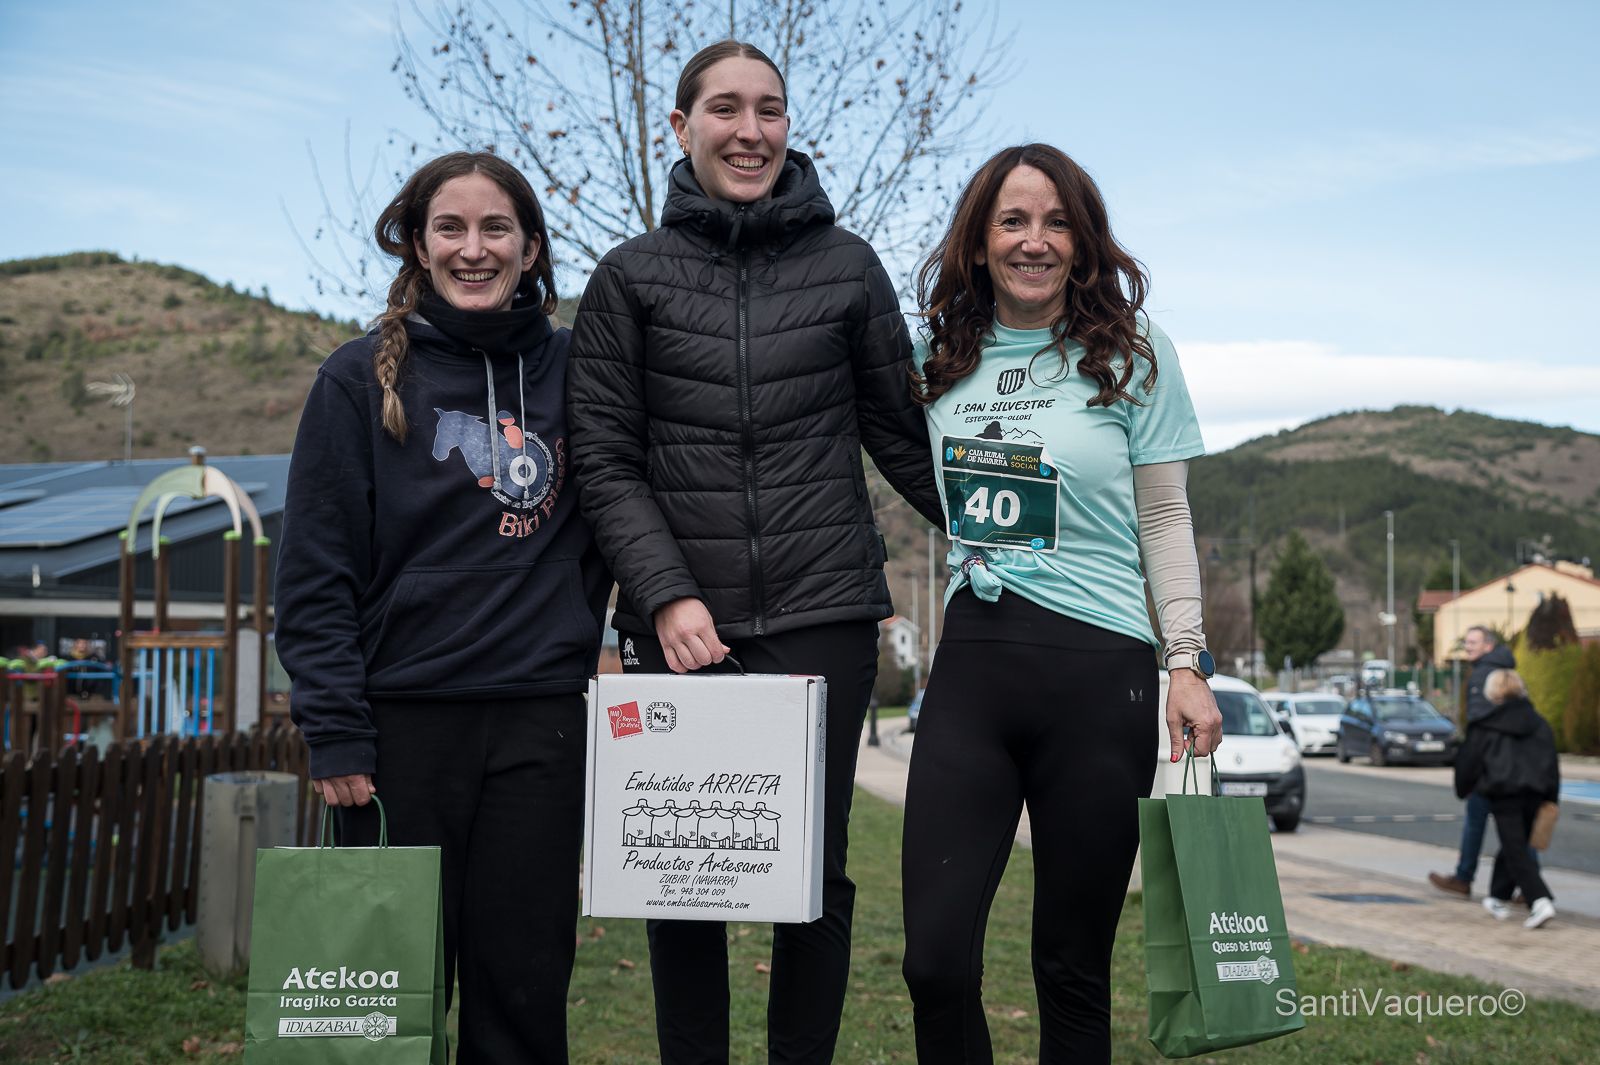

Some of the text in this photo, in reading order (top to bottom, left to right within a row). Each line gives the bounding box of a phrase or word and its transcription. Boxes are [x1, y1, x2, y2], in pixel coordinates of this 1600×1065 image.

[990, 399, 1056, 412] SILVESTRE
[967, 455, 1008, 467] DE NAVARRA
[968, 448, 1006, 460] CAJA RURAL
[1011, 454, 1039, 463] ACCIÓN
[1010, 462, 1038, 471] SOCIAL
[499, 438, 566, 538] Biki Blasco
[965, 486, 1021, 527] 40
[624, 770, 782, 796] Embutidos ARRIETA
[622, 850, 773, 875] Productos Artesanos
[659, 874, 739, 888] ZUBIRI (NAVARRA)
[680, 887, 694, 895] 948
[695, 887, 710, 896] 304
[711, 888, 726, 896] 009
[646, 896, 750, 910] www.embutidosarrieta.com
[1209, 912, 1269, 934] Atekoa
[1212, 938, 1272, 954] Queso de Iragi
[282, 966, 399, 990] Atekoa
[280, 994, 397, 1011] Iragiko Gazta
[285, 1020, 361, 1033] IDIAZABAL
